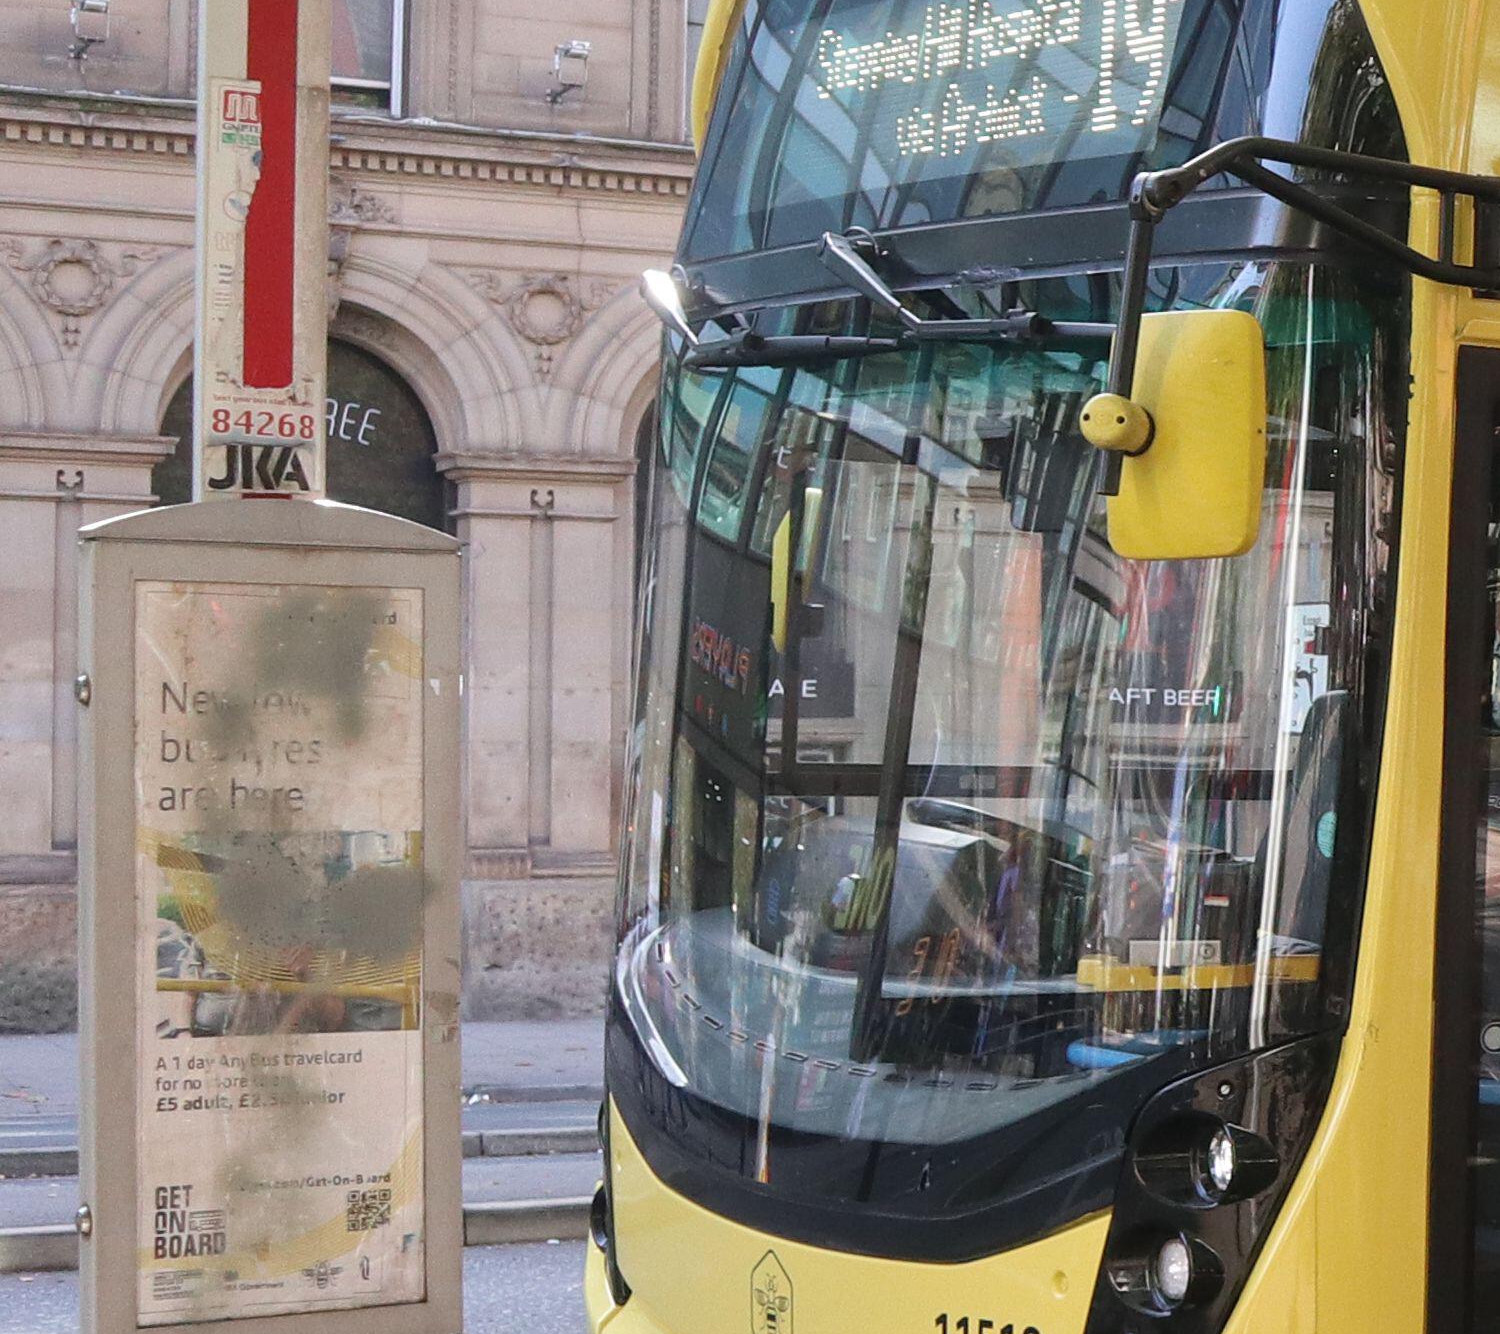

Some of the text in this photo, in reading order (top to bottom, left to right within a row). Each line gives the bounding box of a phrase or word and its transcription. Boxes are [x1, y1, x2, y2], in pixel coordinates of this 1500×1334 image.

[212, 408, 315, 440] 84268
[207, 443, 310, 491] JKA
[156, 1057, 167, 1071] A
[172, 1056, 181, 1070] 1
[284, 1049, 363, 1067] travelcard
[156, 1077, 202, 1092] for no
[156, 1096, 179, 1112] £5
[154, 1184, 192, 1210] GET
[154, 1210, 186, 1235] ON
[154, 1232, 227, 1260] BOARD
